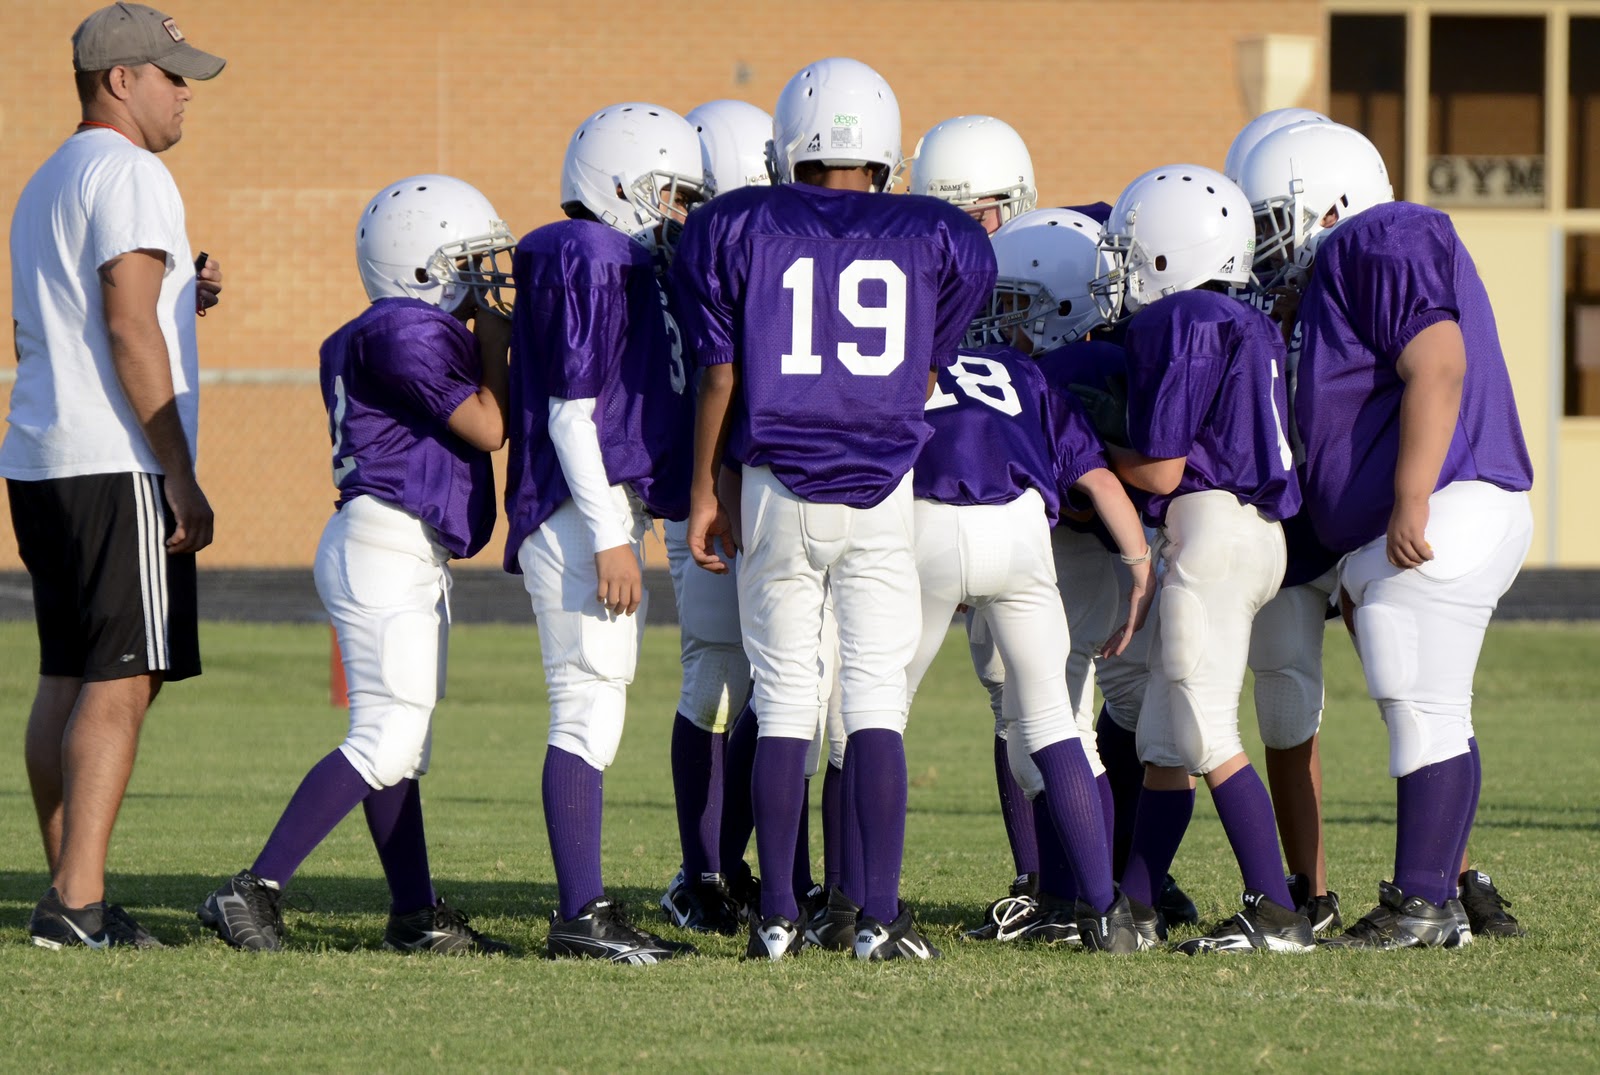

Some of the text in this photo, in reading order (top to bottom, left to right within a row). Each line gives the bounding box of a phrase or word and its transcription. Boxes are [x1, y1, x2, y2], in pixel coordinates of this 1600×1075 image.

[1429, 158, 1546, 195] GYM
[781, 257, 907, 376] 19
[857, 934, 873, 944] NIKE
